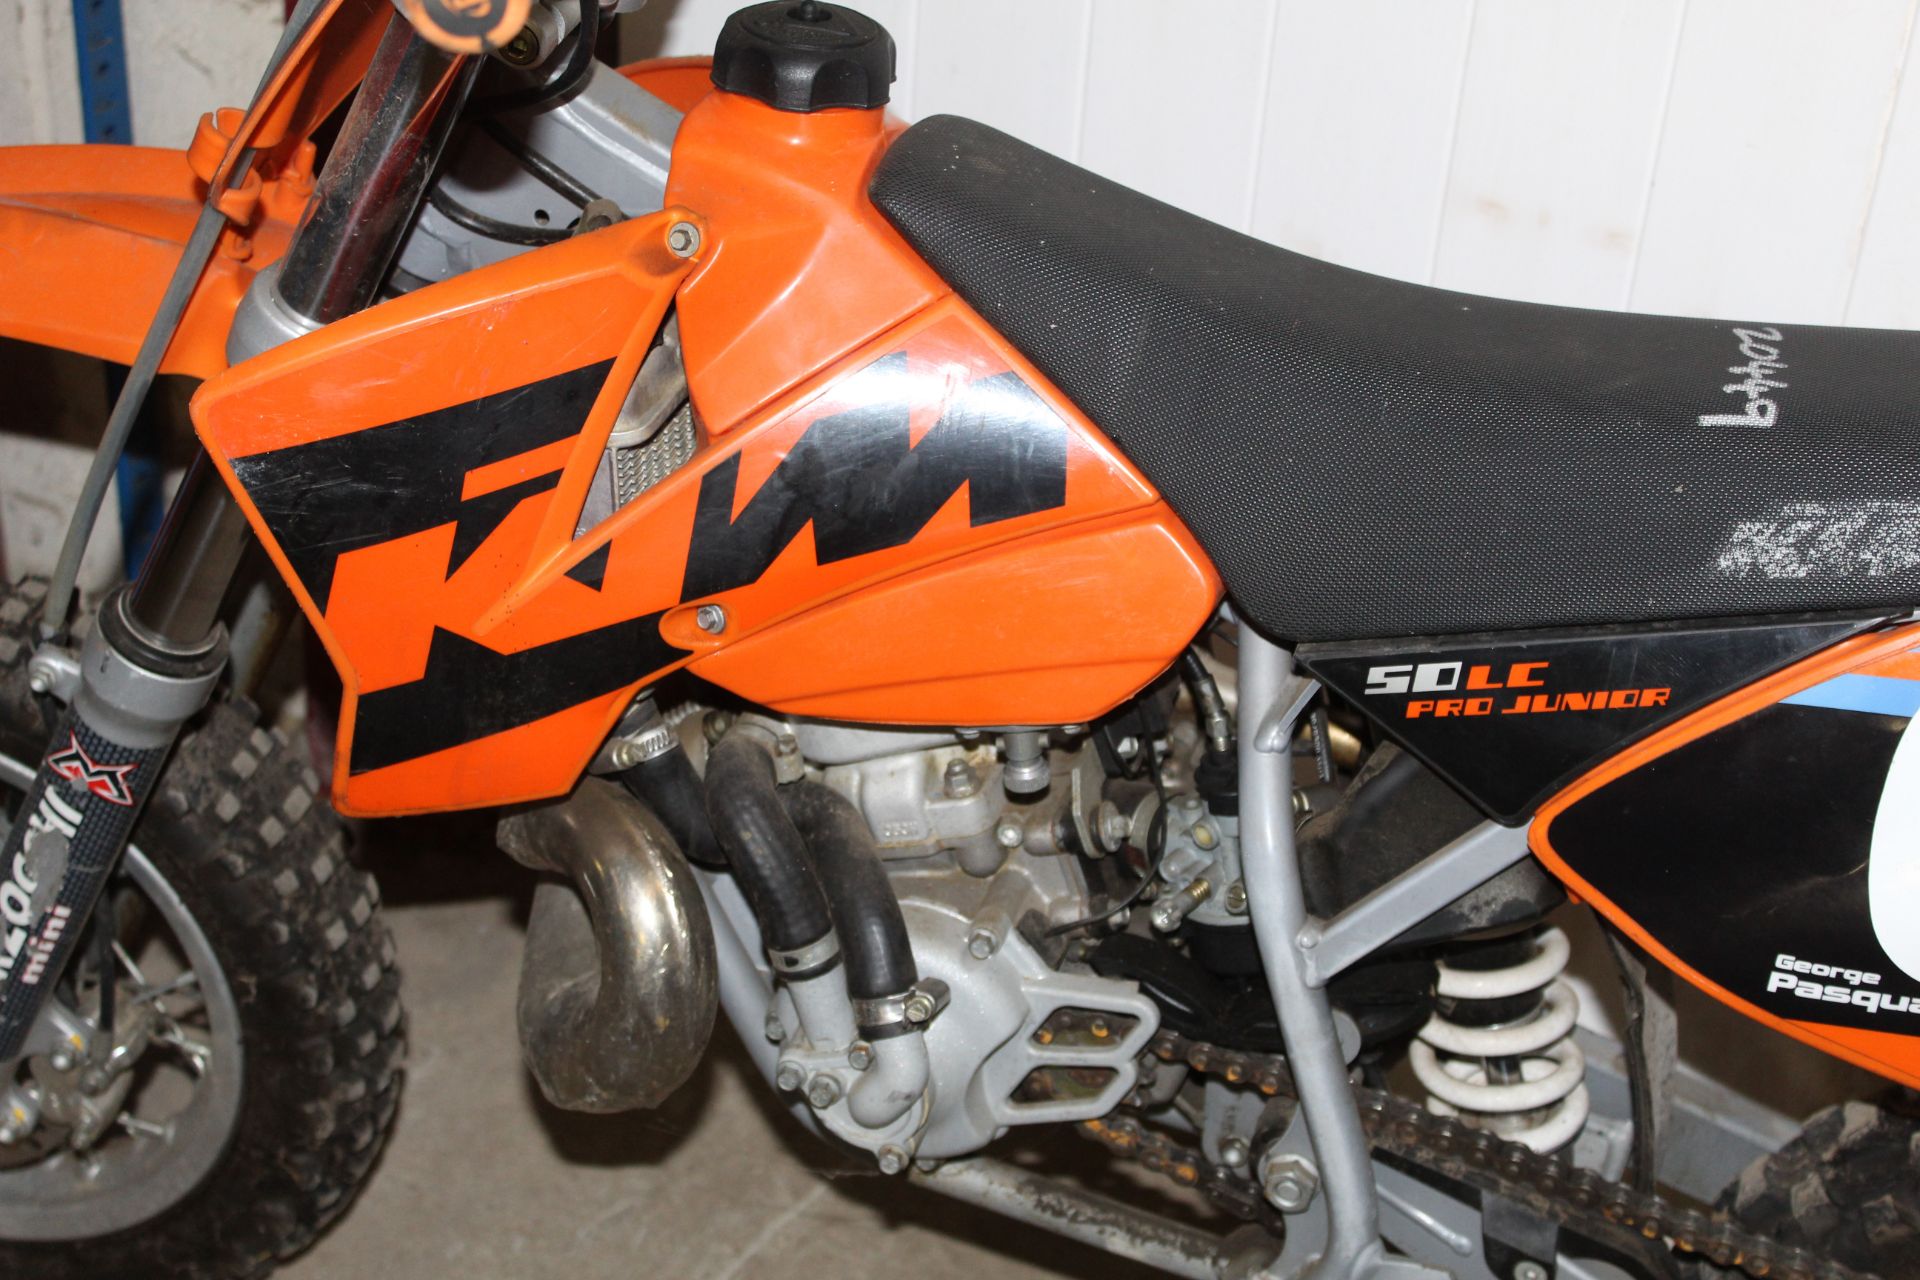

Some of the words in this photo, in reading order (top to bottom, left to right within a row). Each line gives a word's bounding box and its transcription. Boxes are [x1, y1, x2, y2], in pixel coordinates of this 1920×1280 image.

[1697, 327, 1788, 427] 20449
[227, 350, 1067, 774] KTM
[1406, 697, 1493, 718] PRO
[1502, 687, 1671, 714] JUNIOR
[22, 904, 72, 984] mini
[1774, 953, 1882, 986] George
